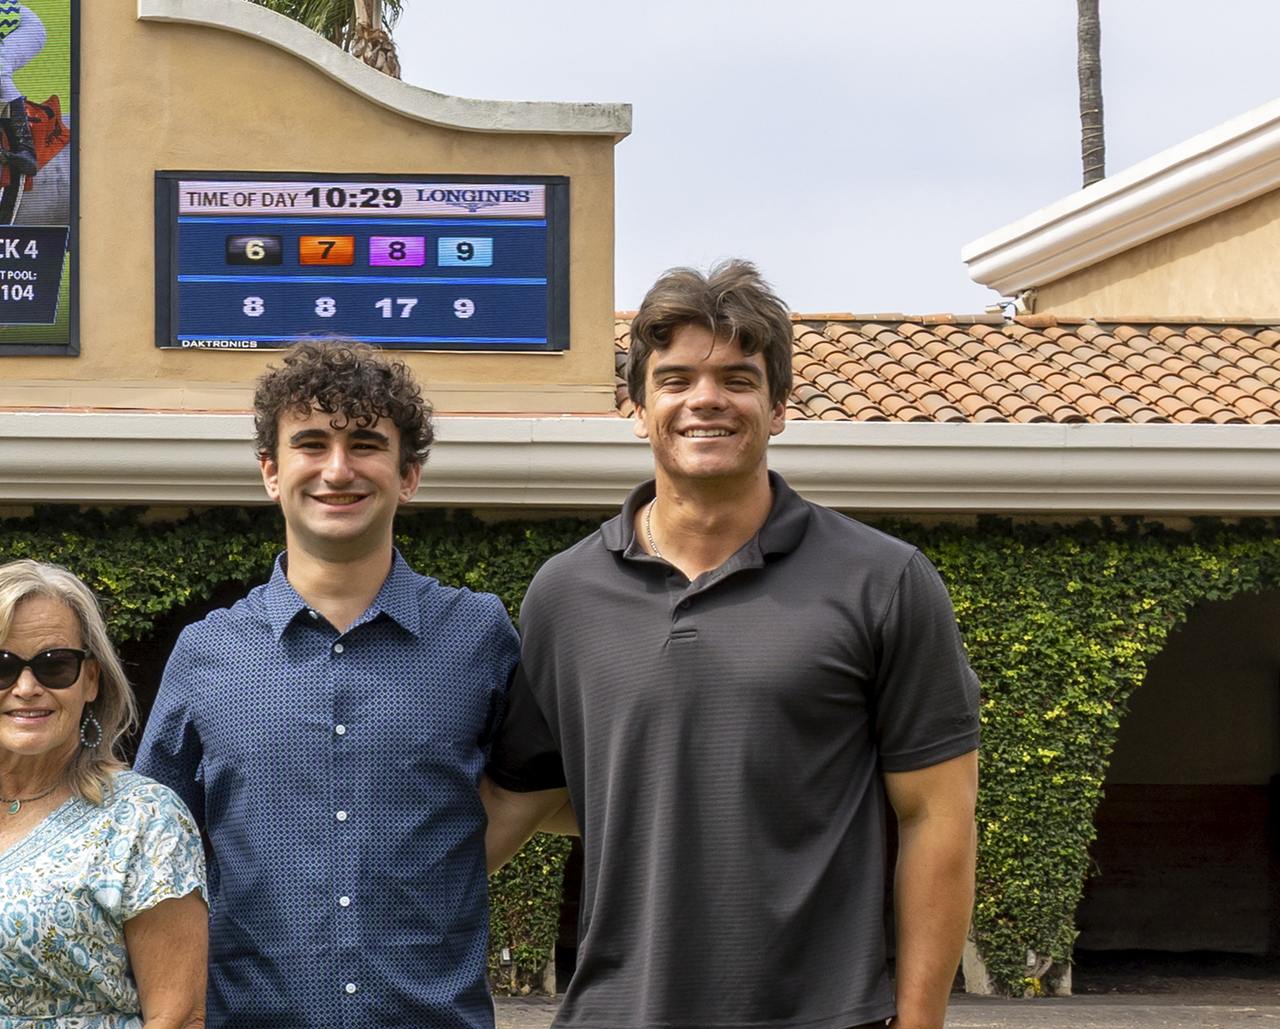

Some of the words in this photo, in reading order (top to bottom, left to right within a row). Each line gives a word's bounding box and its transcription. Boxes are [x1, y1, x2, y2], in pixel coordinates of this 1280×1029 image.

[186, 192, 230, 207] TIME
[233, 192, 257, 207] OF
[261, 193, 298, 208] DAY
[304, 187, 403, 209] 10:29
[416, 189, 530, 204] LONGINES
[24, 240, 38, 258] 4
[246, 239, 265, 259] 6
[318, 241, 336, 259] 7
[388, 241, 406, 260] 8
[456, 242, 474, 261] 9
[8, 271, 37, 280] POOL:
[243, 297, 265, 317] 8
[315, 297, 336, 317] 8
[375, 298, 418, 318] 17
[454, 299, 475, 318] 9
[182, 340, 258, 348] DAKTRONICS
